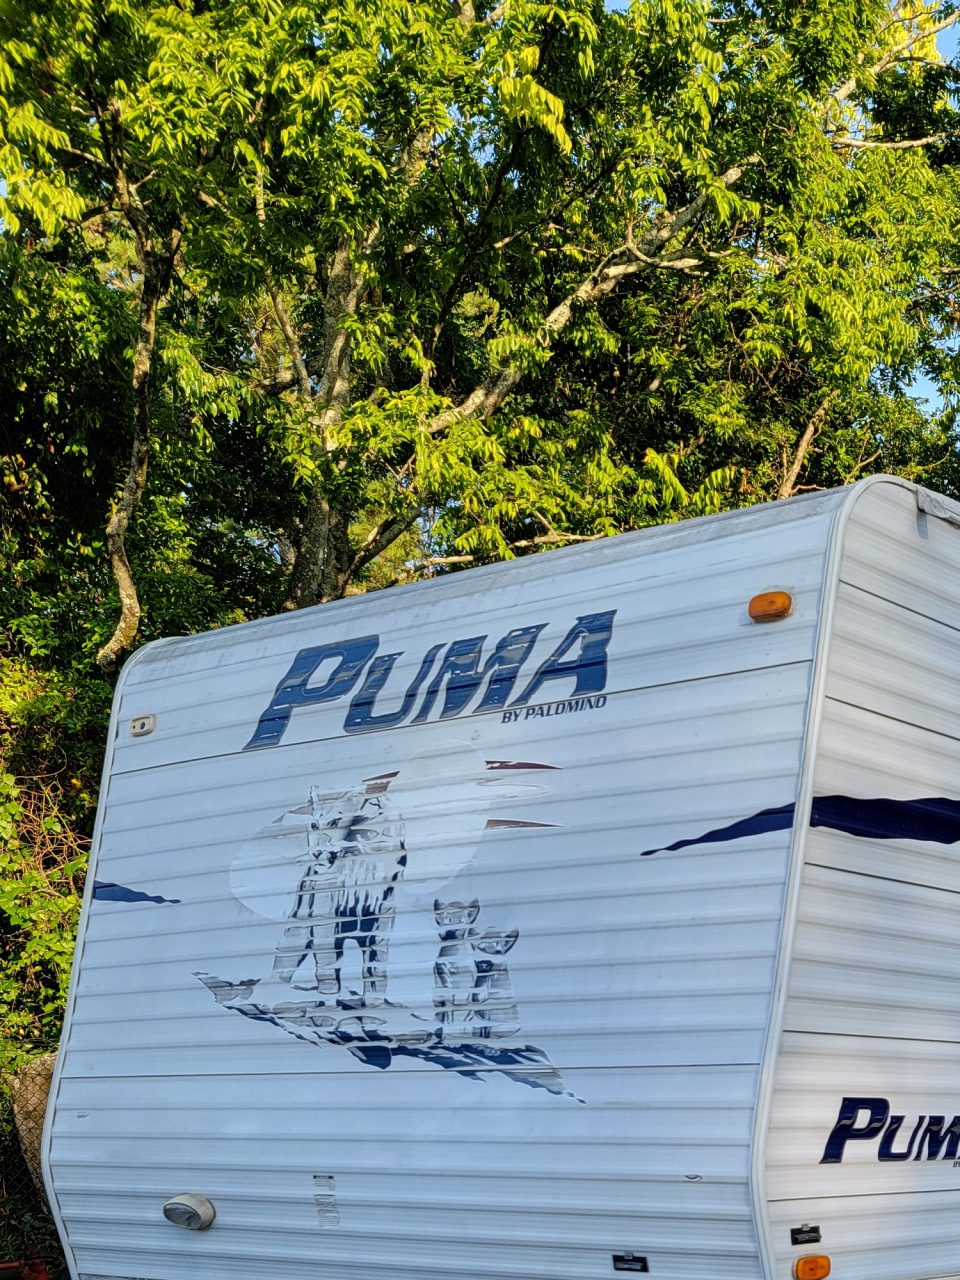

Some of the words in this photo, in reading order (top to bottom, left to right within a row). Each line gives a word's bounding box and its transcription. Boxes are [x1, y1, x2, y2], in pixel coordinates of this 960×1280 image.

[242, 608, 618, 751] PUMA
[501, 710, 521, 724] BY
[524, 695, 607, 720] PALOMINO
